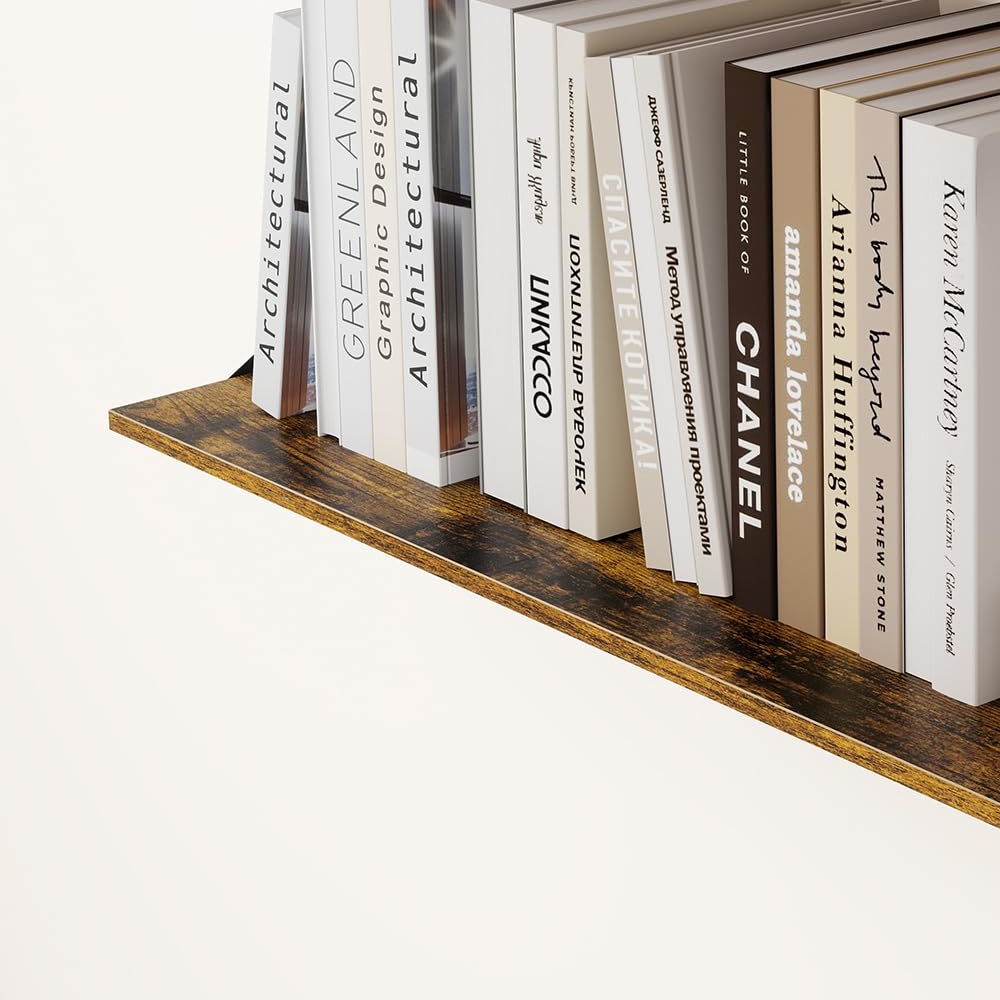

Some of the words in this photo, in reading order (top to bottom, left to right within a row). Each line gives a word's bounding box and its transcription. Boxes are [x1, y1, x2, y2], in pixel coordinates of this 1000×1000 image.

[332, 57, 367, 361] GREENLAND
[369, 86, 388, 207] Design
[647, 95, 662, 147] ДЖЕФФ
[655, 150, 671, 224] САЗЕРЛЕНД
[737, 131, 748, 186] LITTLE
[866, 154, 887, 226] The
[258, 81, 291, 364] Architectural
[397, 52, 428, 389] Architectural
[738, 191, 750, 245] BOOK
[740, 250, 750, 276] OF
[831, 193, 852, 341] Arianna
[867, 239, 894, 310] body
[943, 179, 965, 268] Karen
[371, 225, 394, 361] Graphic
[602, 173, 639, 318] СПАСИТЕ
[621, 329, 657, 471] КОТИКА!
[784, 224, 806, 357] amanda
[935, 272, 966, 438] McCartney
[665, 246, 681, 312] Метод
[688, 446, 712, 556] проектами
[735, 320, 762, 540] CHANEL
[786, 361, 808, 504] lovelace
[859, 329, 892, 442] beyond
[828, 356, 854, 555] Huffington
[874, 475, 885, 567] MATTHEW
[876, 572, 887, 633] STONE
[945, 572, 955, 600] Glen
